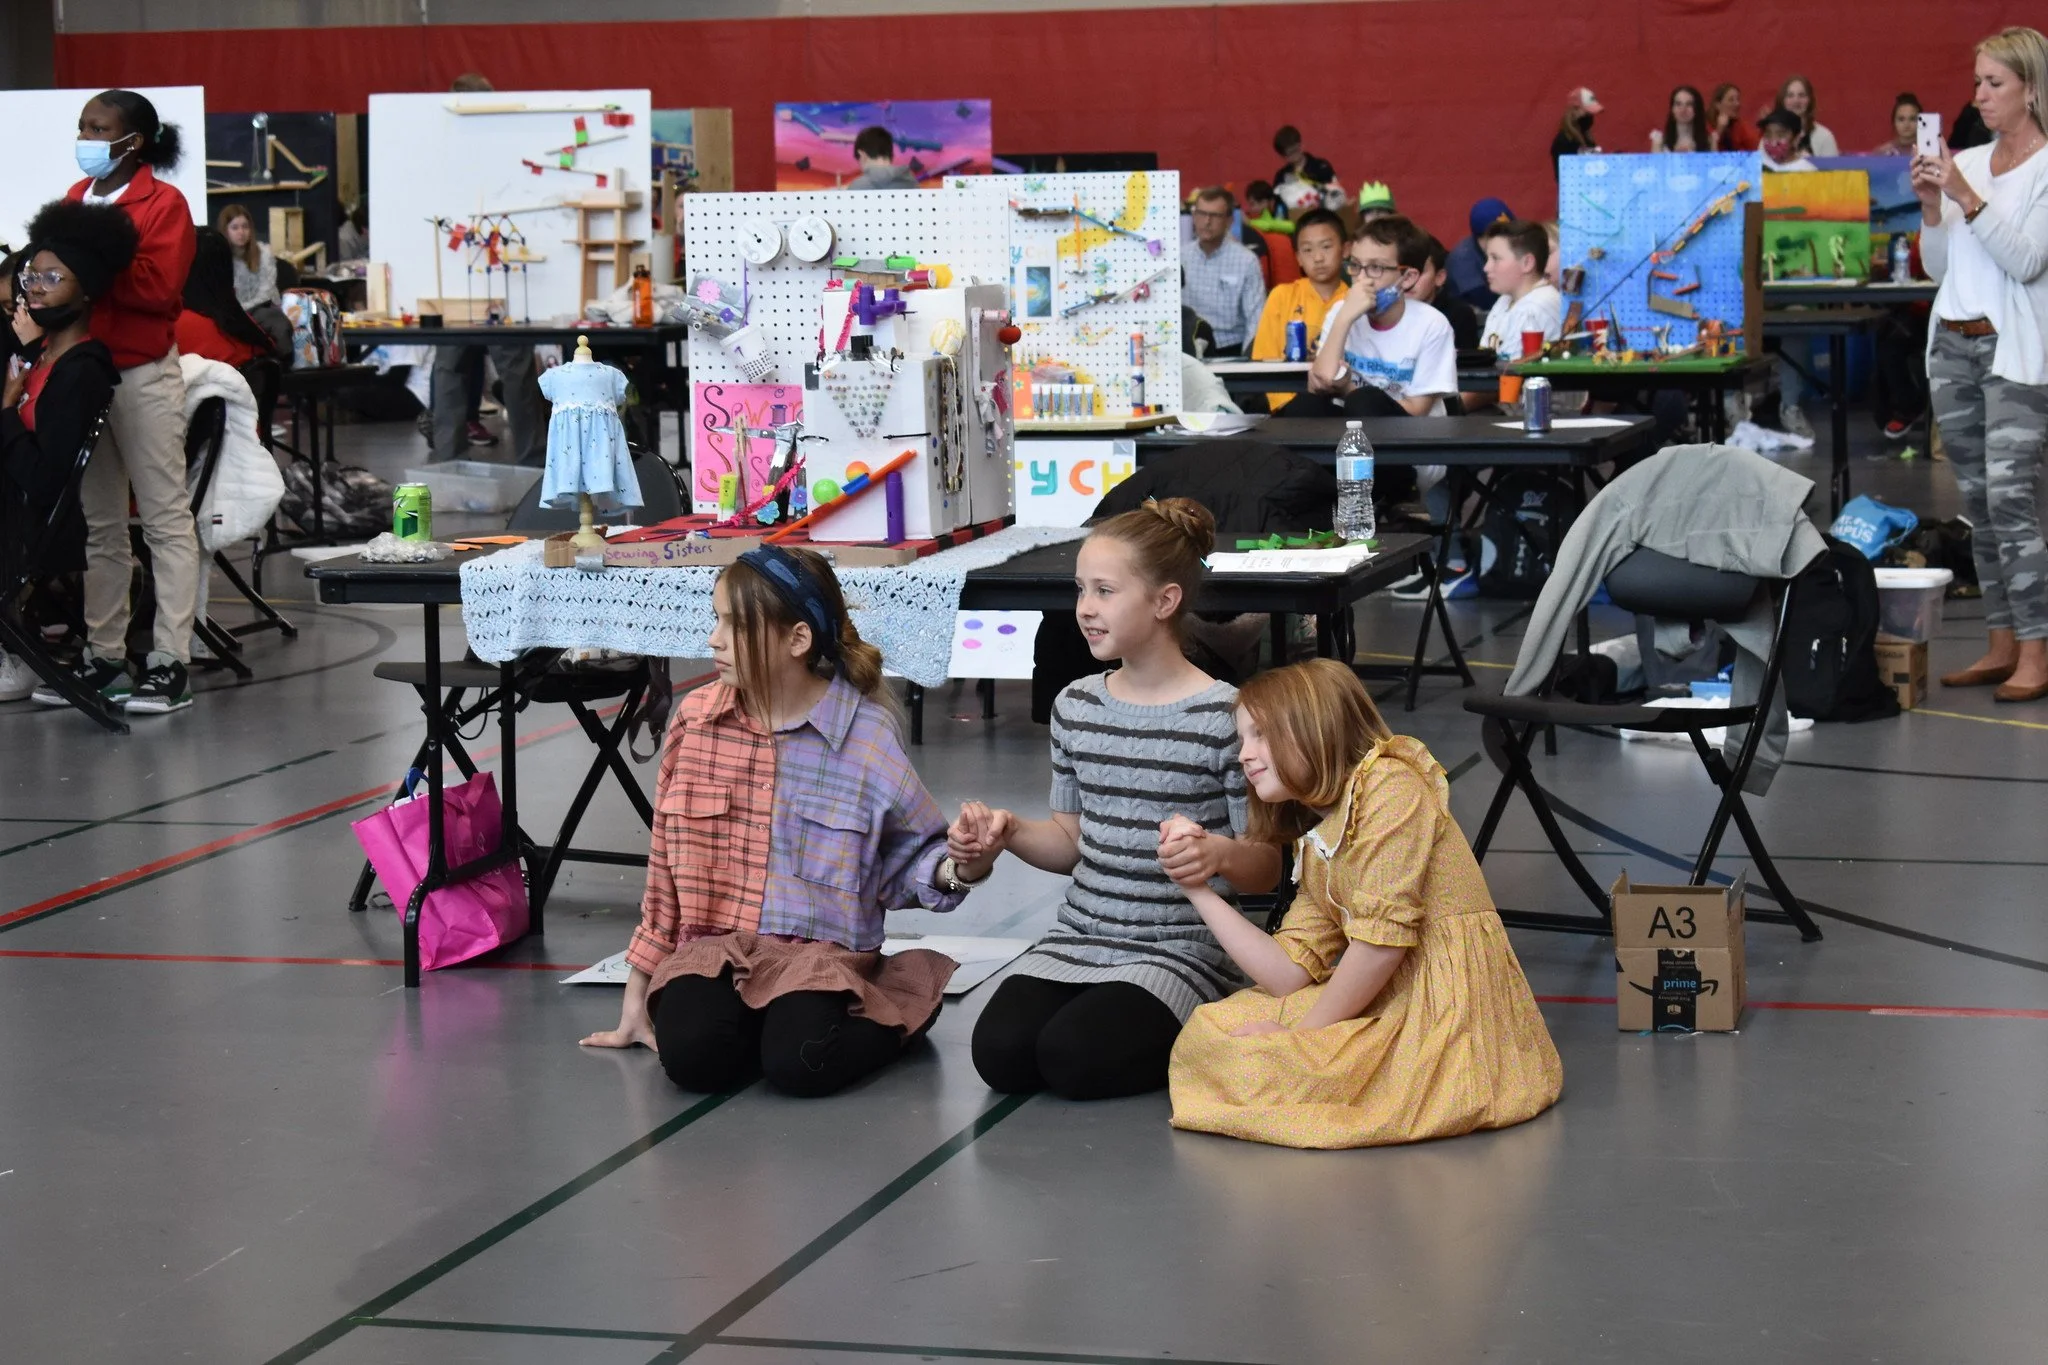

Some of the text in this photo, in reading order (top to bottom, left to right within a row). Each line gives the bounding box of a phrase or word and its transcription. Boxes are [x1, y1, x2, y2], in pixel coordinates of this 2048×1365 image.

[1015, 460, 1132, 496] YCH
[605, 542, 713, 565] Sewing Sisters
[1648, 906, 1697, 939] A3
[1664, 978, 1696, 990] prime
